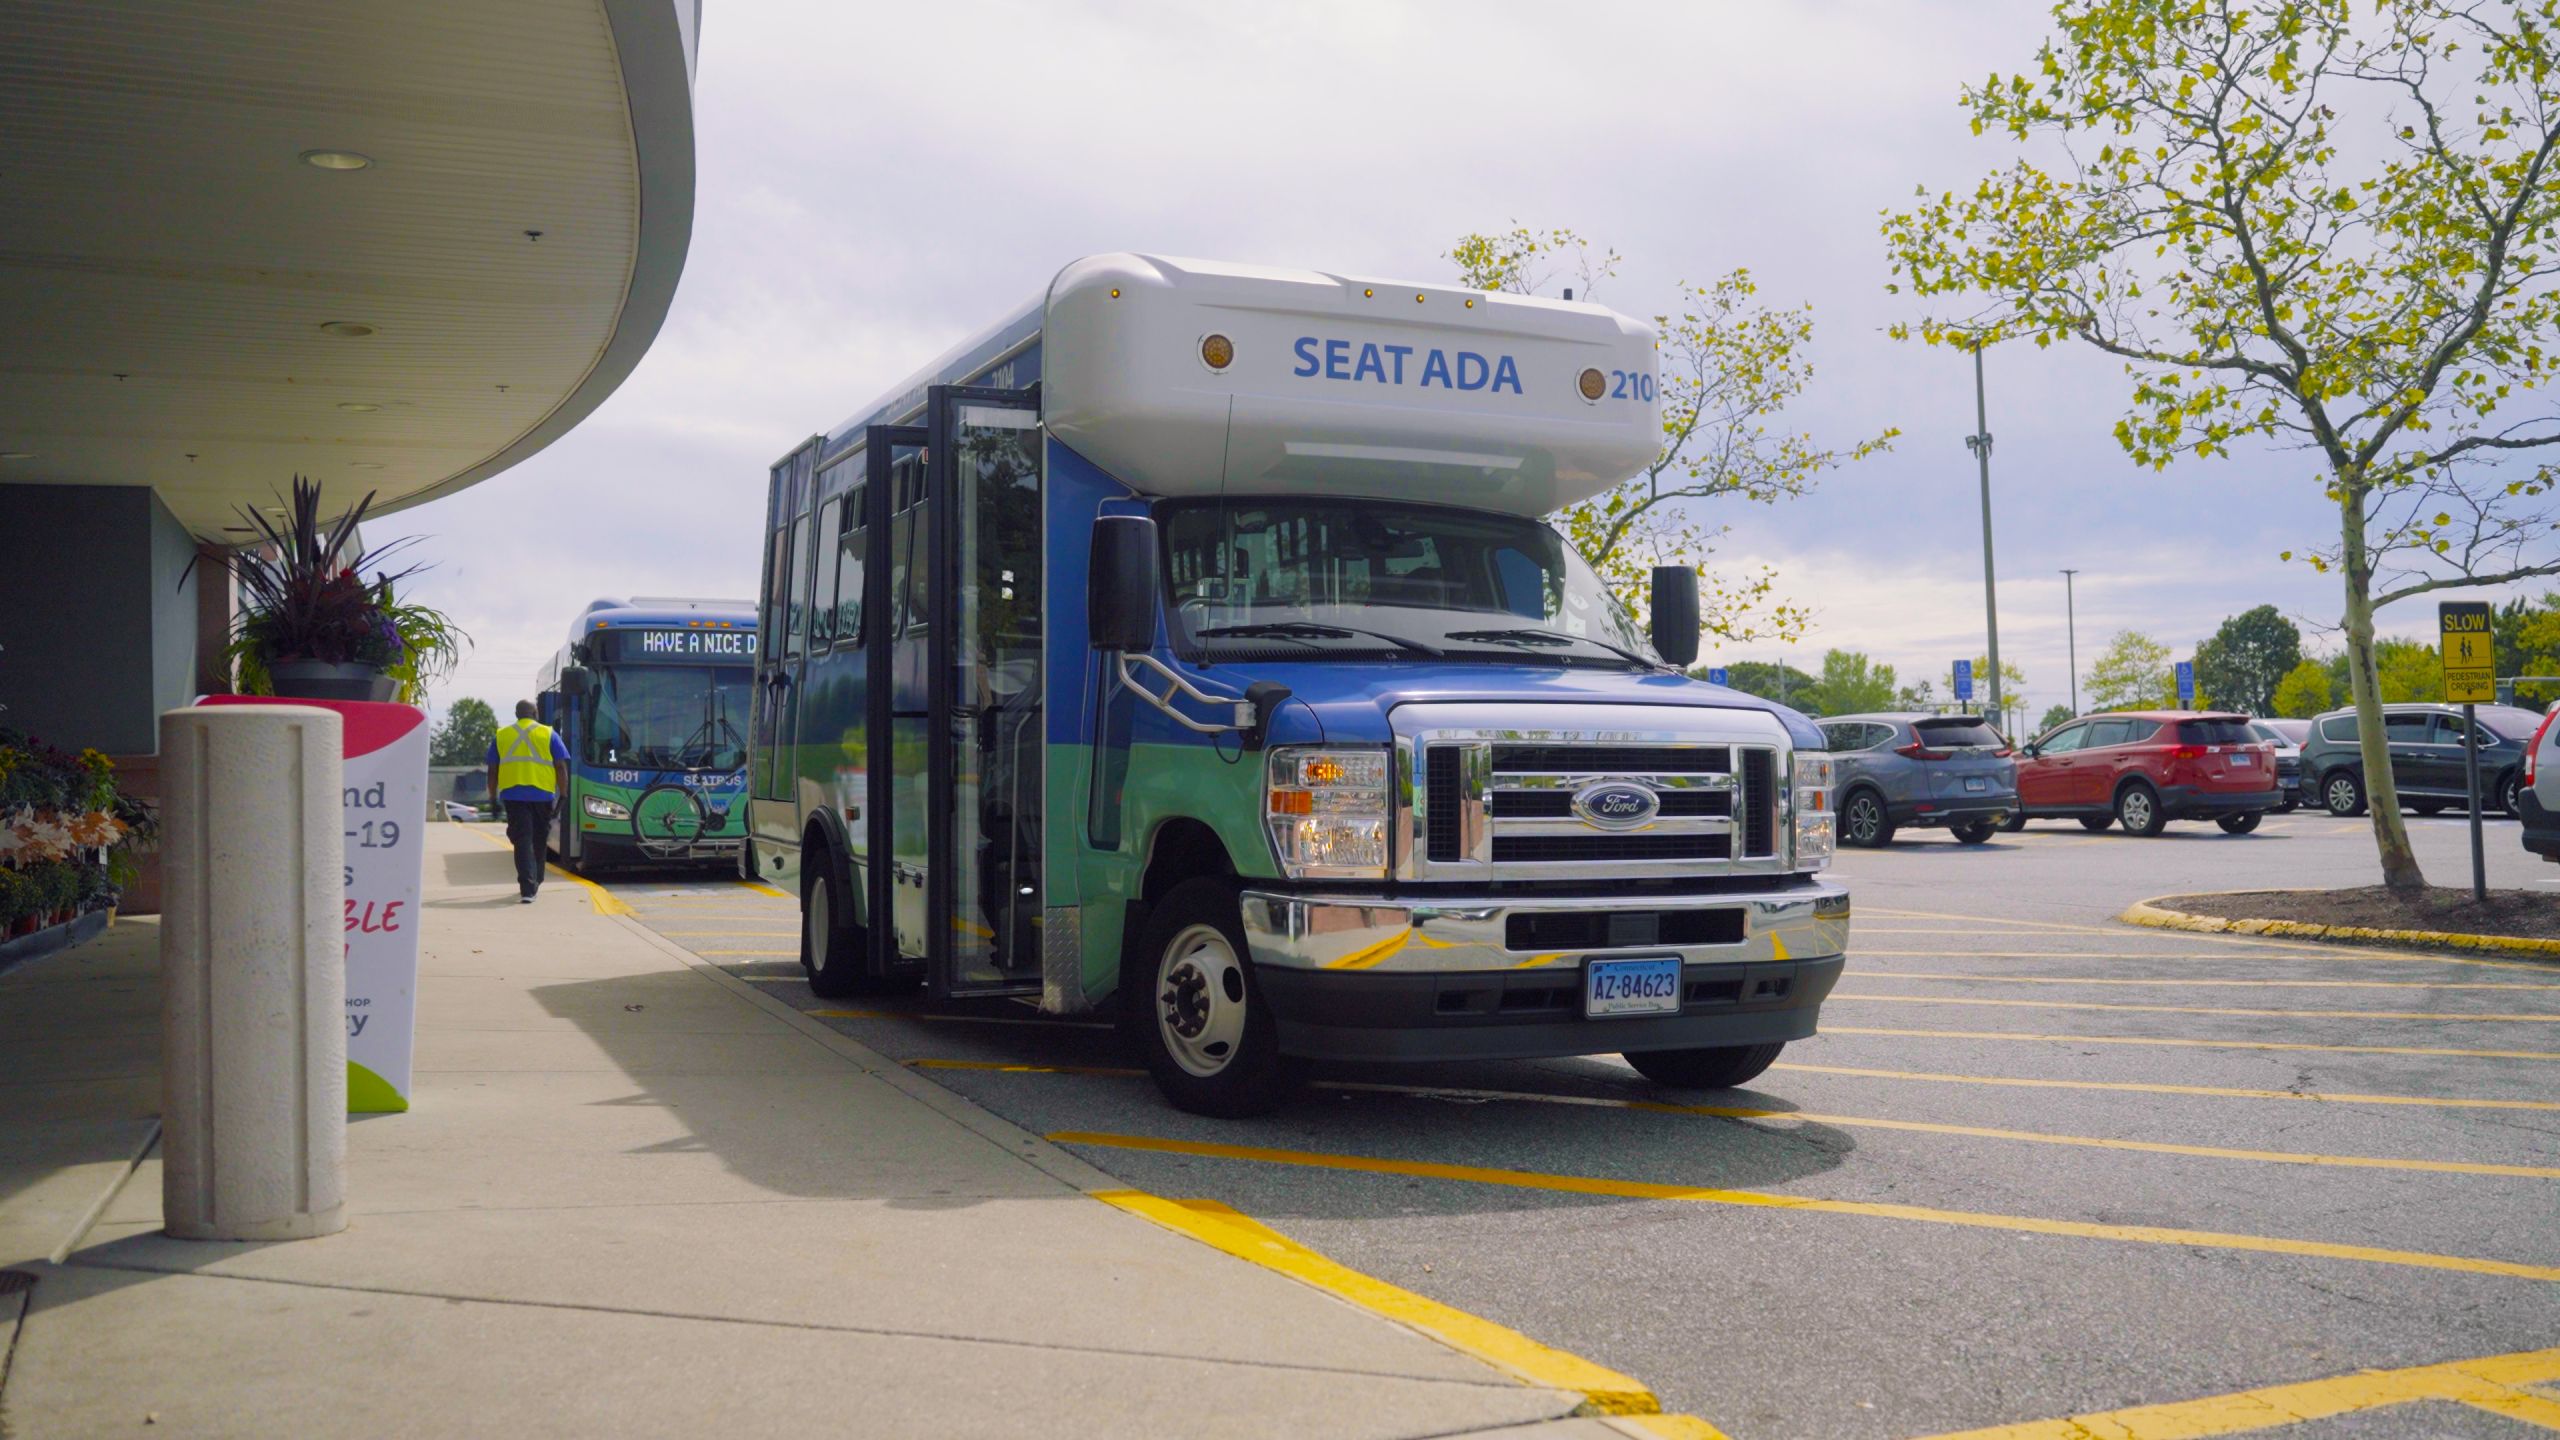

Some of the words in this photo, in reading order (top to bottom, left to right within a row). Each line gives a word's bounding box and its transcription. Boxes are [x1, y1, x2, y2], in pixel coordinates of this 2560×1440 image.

[1293, 336, 1413, 385] SEAT
[1420, 349, 1523, 395] ADA
[2444, 613, 2485, 631] SLOW
[643, 631, 684, 652] HAVE
[689, 633, 699, 653] A
[704, 633, 742, 653] NICE
[747, 634, 757, 654] D
[2447, 671, 2491, 681] PEDESTRIAN
[2450, 681, 2489, 691] CROSSING
[608, 749, 617, 762] 1
[608, 770, 640, 783] 1801
[343, 781, 386, 808] nd
[1602, 794, 1639, 813] Ford
[344, 820, 400, 849] -19
[344, 899, 405, 933] BLE
[345, 998, 371, 1007] HOP
